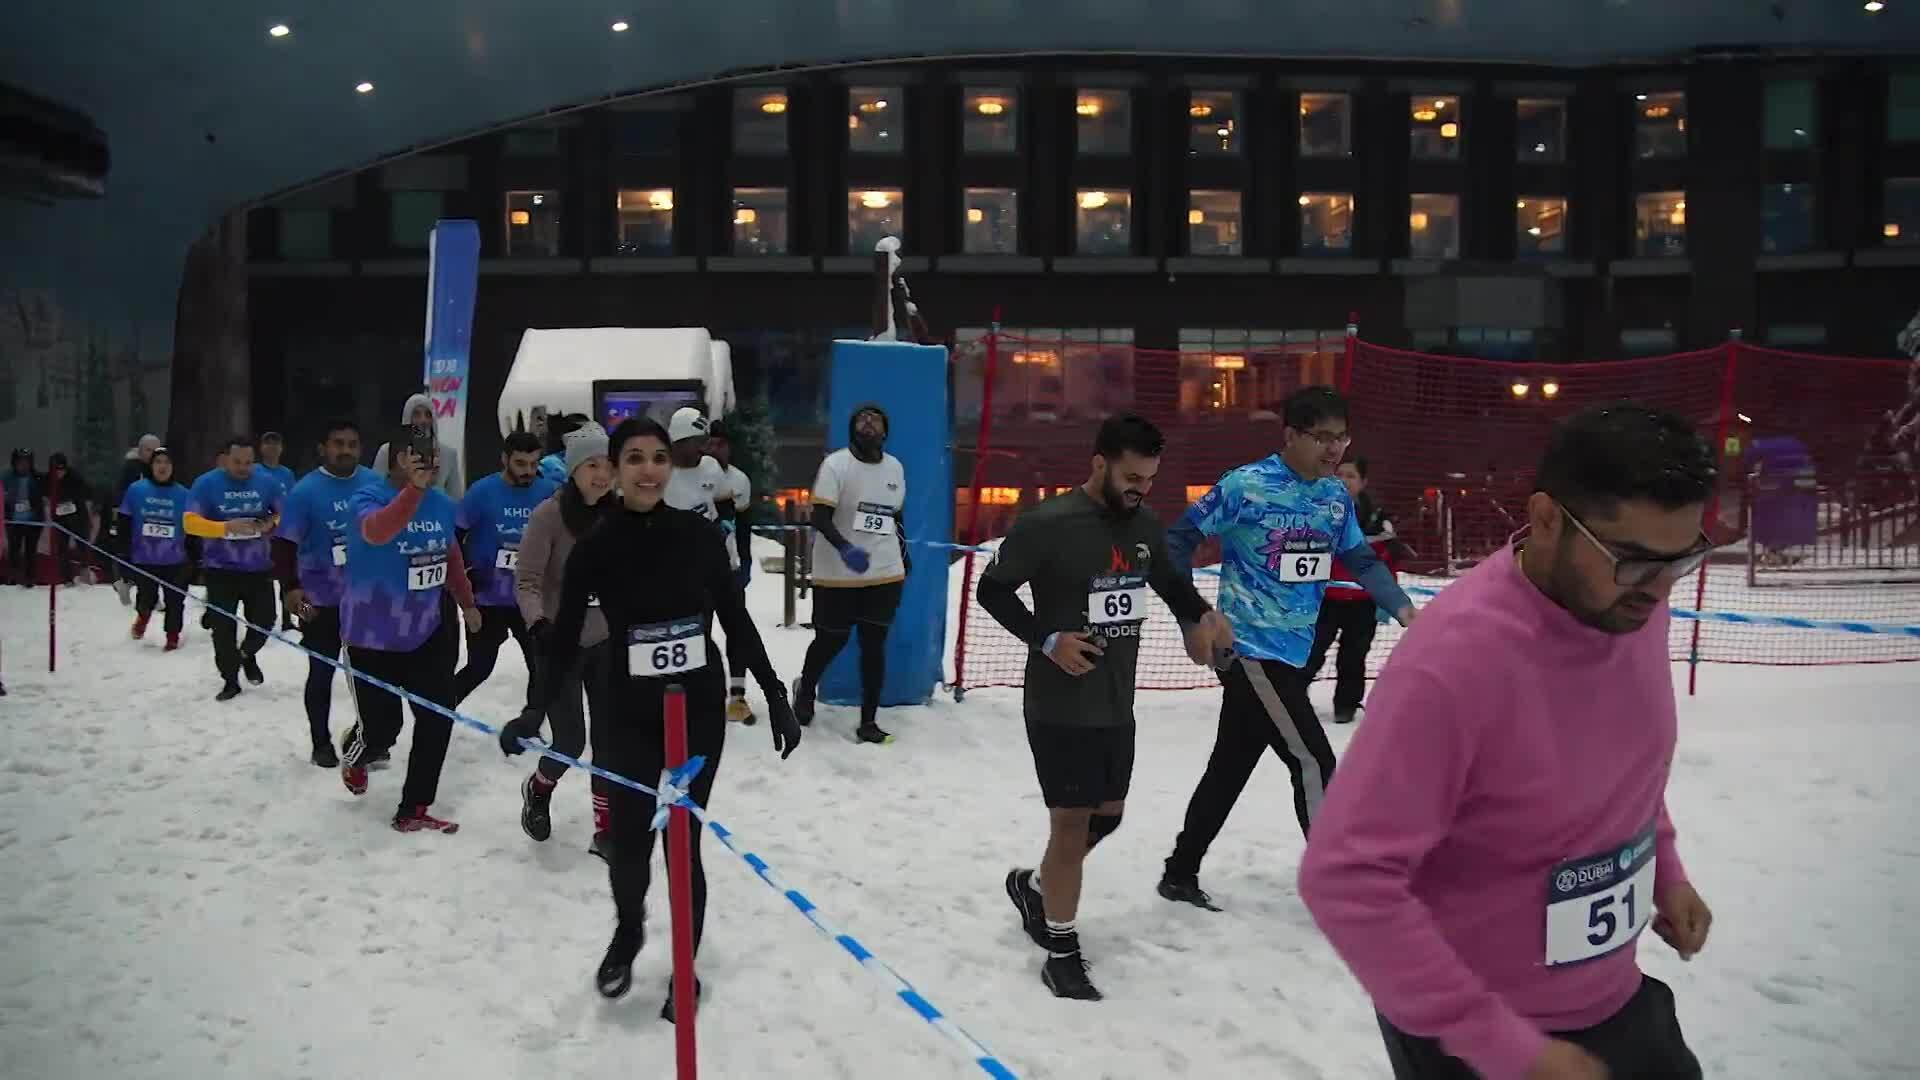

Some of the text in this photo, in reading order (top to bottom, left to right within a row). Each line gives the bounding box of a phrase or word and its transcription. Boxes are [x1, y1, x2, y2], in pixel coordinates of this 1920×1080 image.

[504, 507, 531, 518] KHD
[407, 520, 442, 533] KHDA
[415, 566, 443, 586] 170
[1295, 556, 1320, 577] 67
[1104, 593, 1132, 617] 69
[652, 642, 688, 670] 68
[1587, 884, 1635, 946] 51
